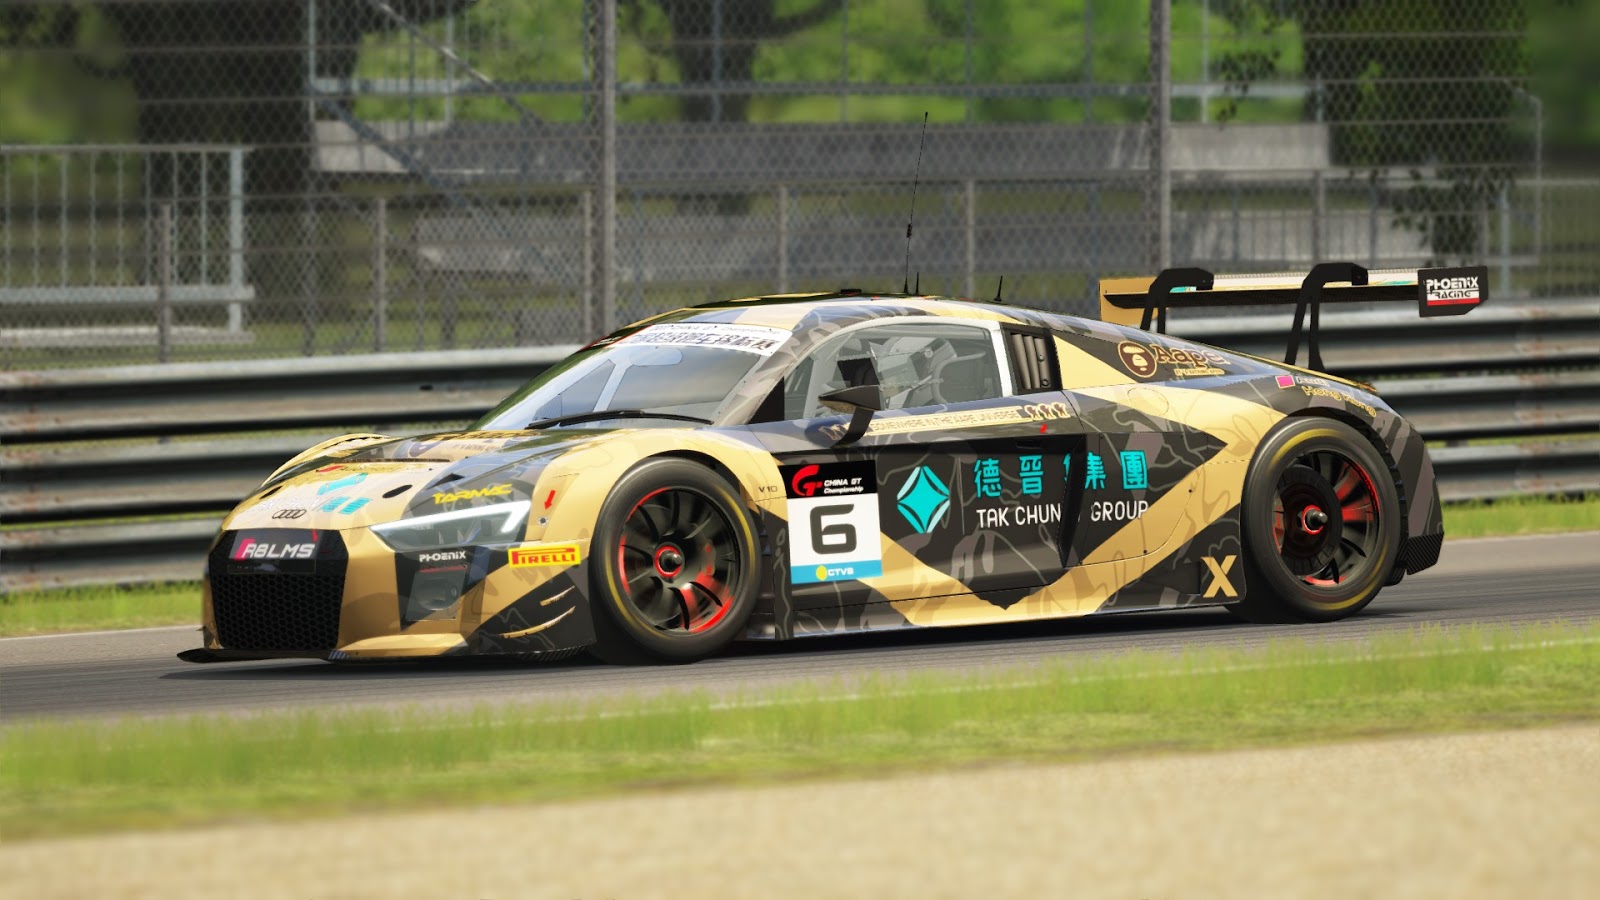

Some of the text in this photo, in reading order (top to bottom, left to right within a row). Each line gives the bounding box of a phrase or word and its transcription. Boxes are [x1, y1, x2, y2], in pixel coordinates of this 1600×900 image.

[432, 483, 513, 505] TARMAC
[824, 479, 848, 487] CHINA
[976, 507, 1010, 528] TAK
[1090, 500, 1149, 522] GROUP
[810, 504, 857, 555] 6
[512, 547, 576, 565] PIRELLI
[1200, 554, 1239, 598] X
